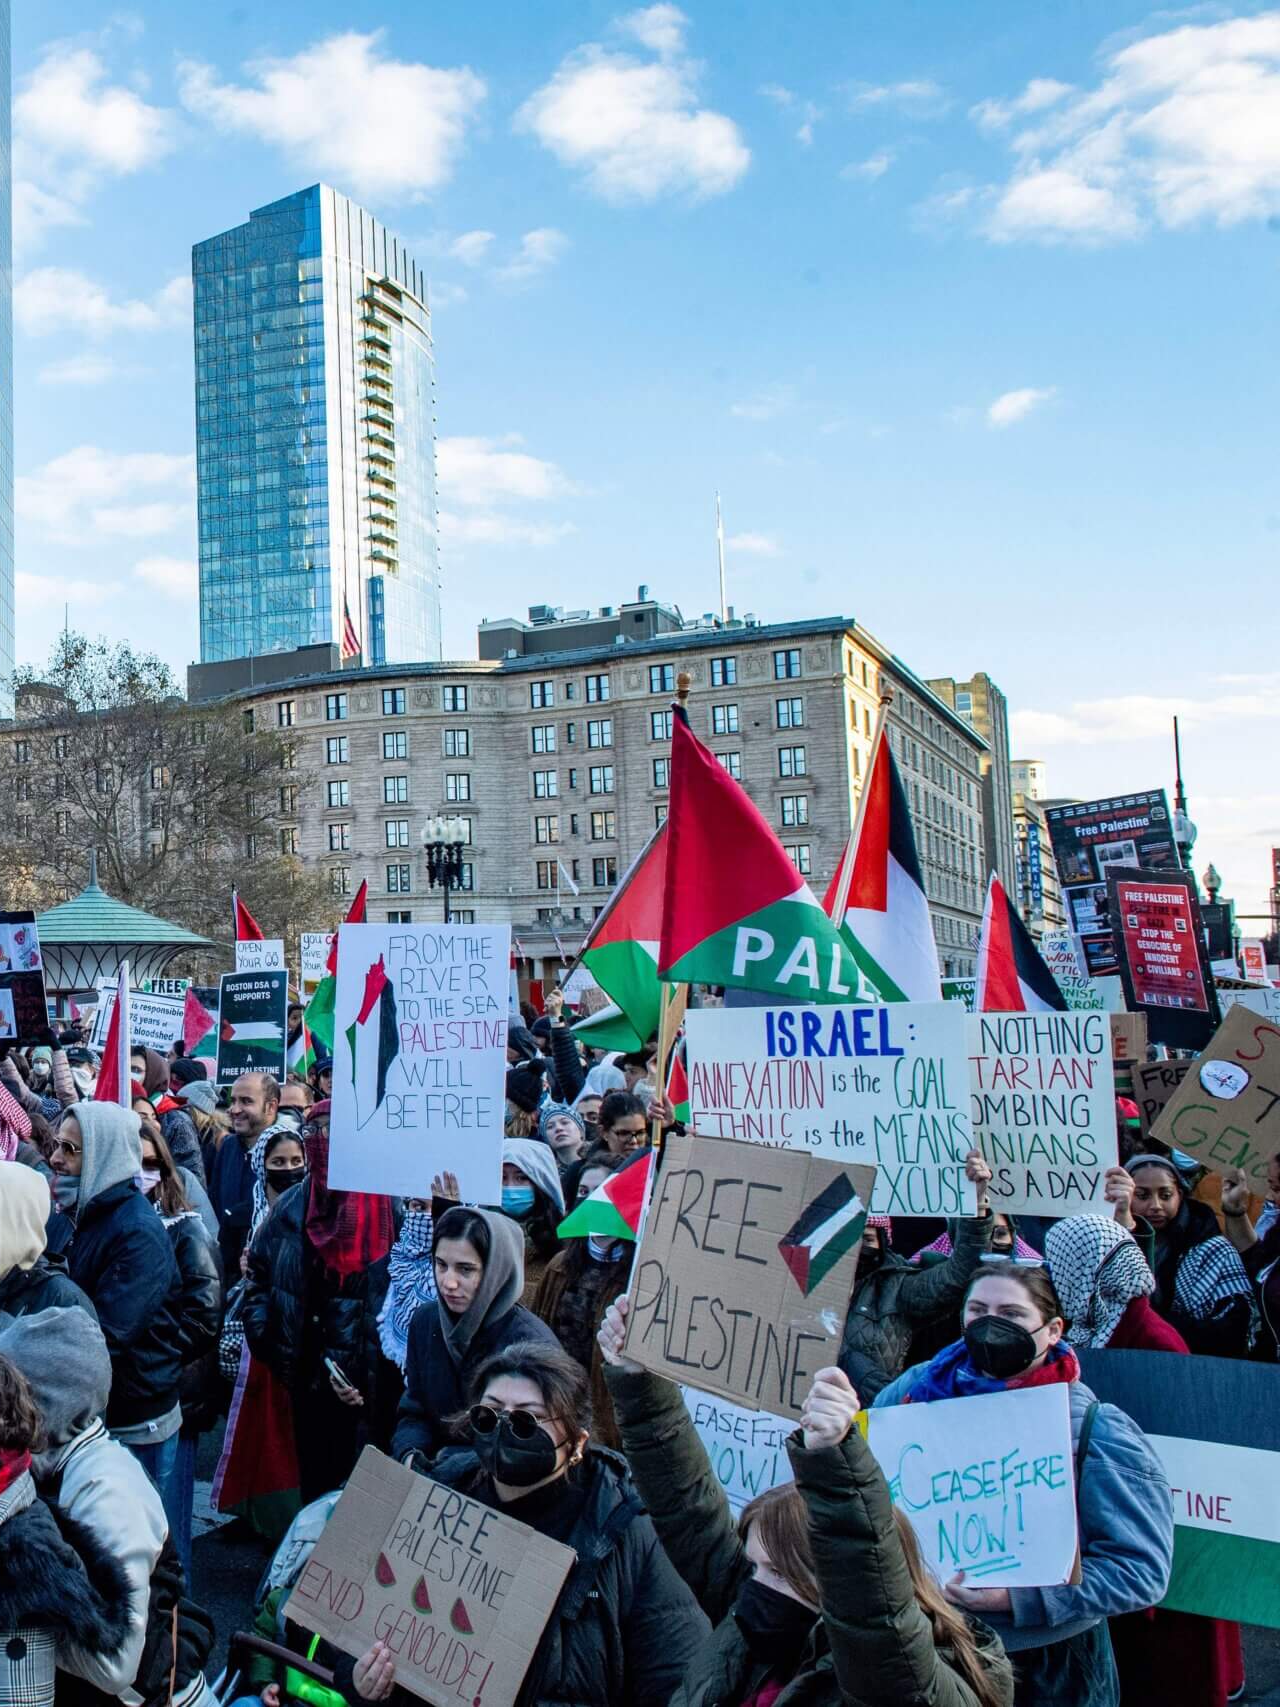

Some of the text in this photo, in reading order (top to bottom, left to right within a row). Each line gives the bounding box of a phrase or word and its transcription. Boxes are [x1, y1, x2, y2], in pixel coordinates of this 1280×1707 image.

[1075, 825, 1098, 838] Free
[1100, 816, 1150, 833] Palestine
[1125, 892, 1185, 905] FREE PALESTINE
[1142, 928, 1175, 940] STOP THE
[237, 943, 262, 953] OPEN
[389, 934, 493, 966] FROM THE
[1046, 952, 1076, 964] WOR
[1047, 941, 1068, 952] FOR
[1137, 940, 1182, 953] GENOCIDE OF
[1144, 952, 1179, 964] INNOCENT
[400, 963, 489, 994] RIVER
[1146, 965, 1182, 977] CIVILIANS
[152, 979, 182, 994] FREE
[226, 980, 270, 992] BOSTON DSA
[233, 991, 271, 1002] SUPPORTS
[140, 1003, 184, 1017] responsible
[398, 995, 499, 1020] TO THE SEA
[138, 1016, 160, 1026] years
[134, 1026, 174, 1041] bloodshed
[399, 1019, 507, 1054] PALESTINE
[980, 1015, 1104, 1055] NOTHING
[246, 1054, 252, 1062] A
[221, 1067, 239, 1076] FREE
[400, 1058, 472, 1088] WILL
[692, 1057, 956, 1110] ANNEXATION is the GOAL
[385, 1093, 492, 1130] BE FREE
[805, 1126, 822, 1146] is
[829, 1120, 866, 1147] the
[874, 1112, 972, 1164] MEANS
[973, 1131, 1098, 1167] INIANS
[1026, 1169, 1044, 1198] A
[1047, 1170, 1101, 1201] DAY
[653, 1169, 783, 1266] FREE
[625, 1259, 826, 1411] PALESTINE
[417, 1483, 498, 1555] FREE
[938, 1493, 1025, 1565] NOW!
[389, 1518, 514, 1611] PALESTINE
[297, 1560, 494, 1707] END GENOCIDE!
